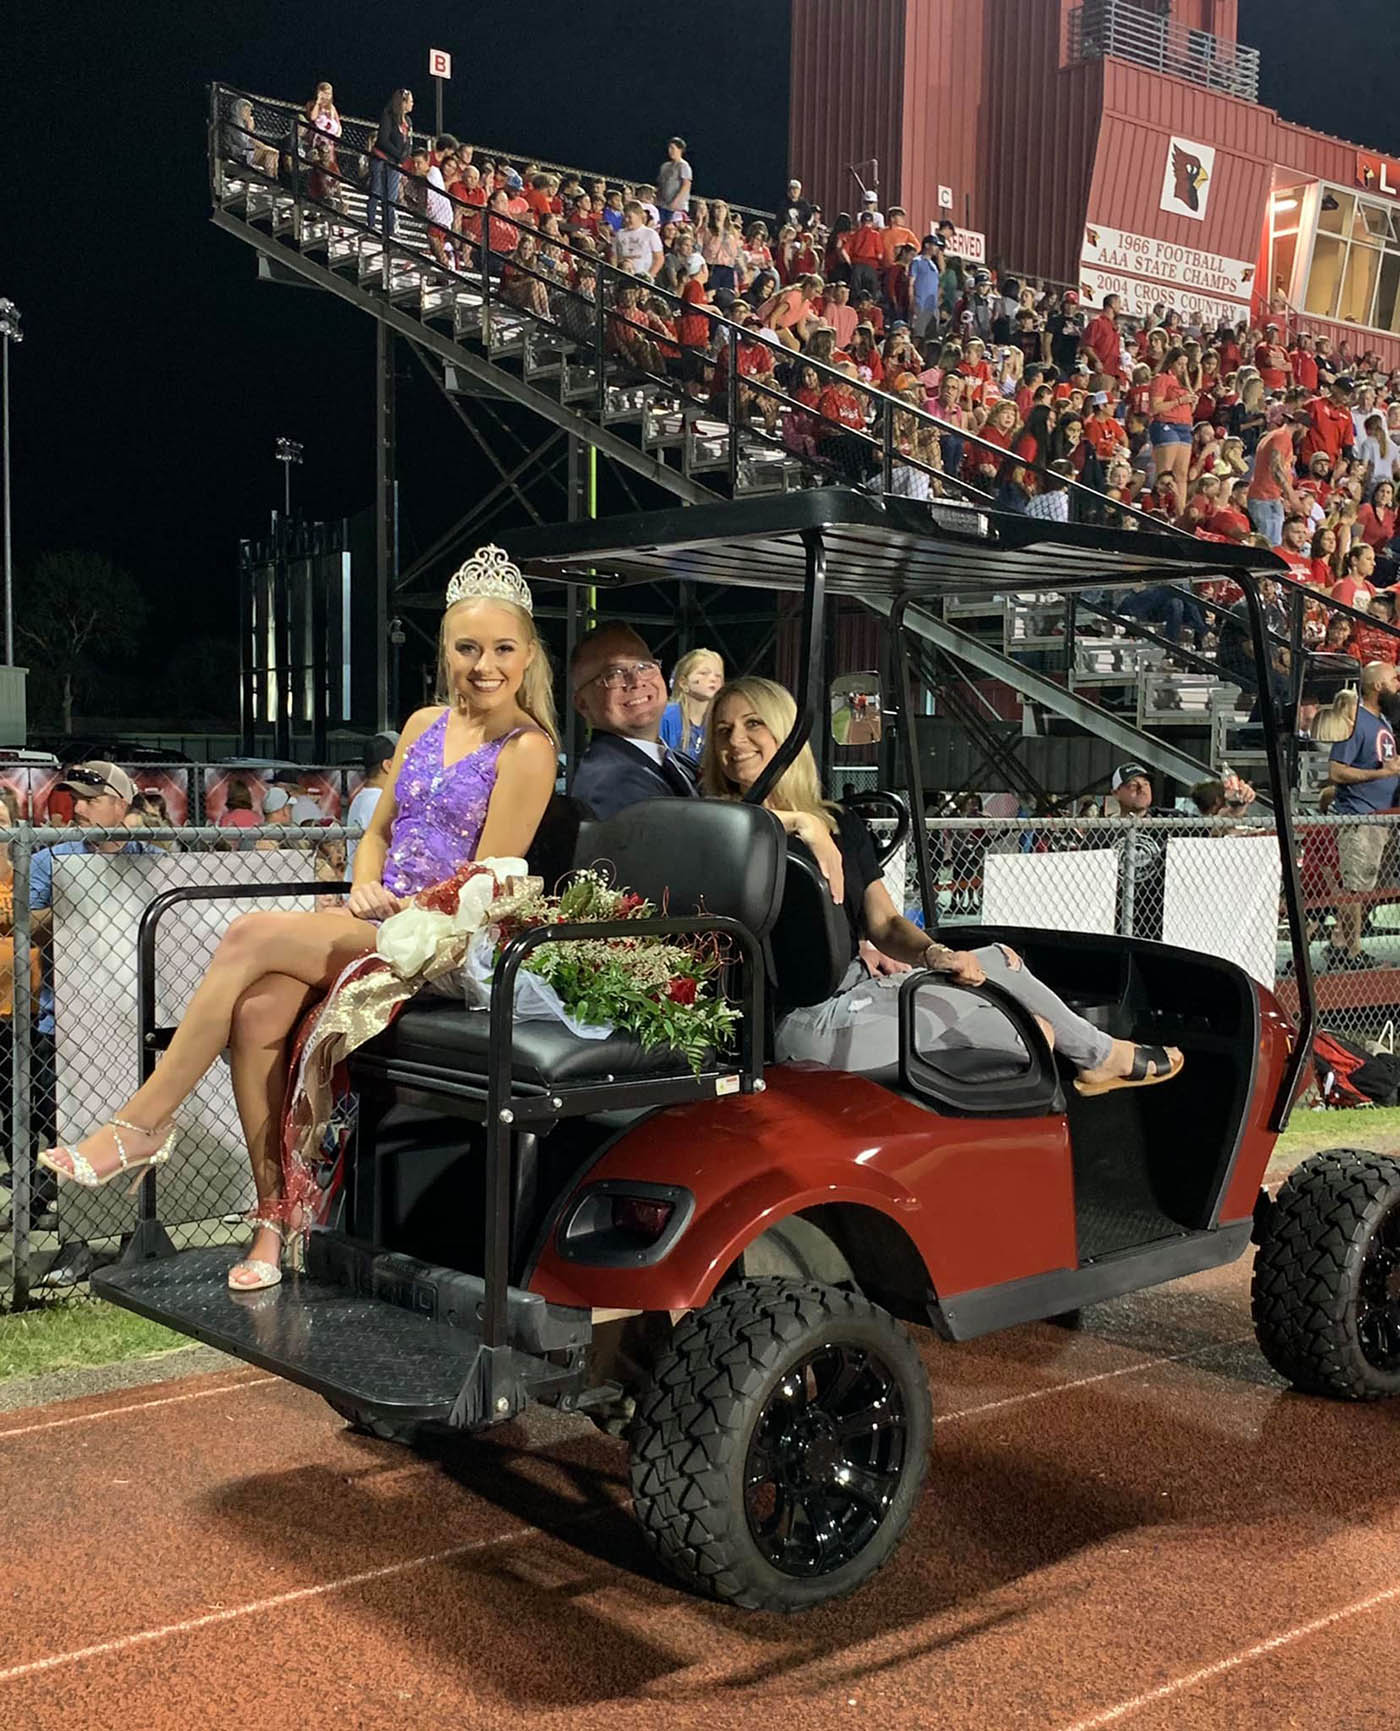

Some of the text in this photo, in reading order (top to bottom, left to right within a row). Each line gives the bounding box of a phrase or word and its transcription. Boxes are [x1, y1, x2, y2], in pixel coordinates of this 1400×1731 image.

[435, 55, 446, 73] B
[941, 190, 950, 204] C
[1379, 162, 1397, 196] L
[1098, 247, 1238, 293] AAA STATE CHAMPS
[1118, 233, 1225, 273] 1966 FOOTBALL
[1097, 274, 1128, 295] 2004
[1134, 282, 1175, 305] CROSS
[1180, 293, 1237, 321] COUNTRY
